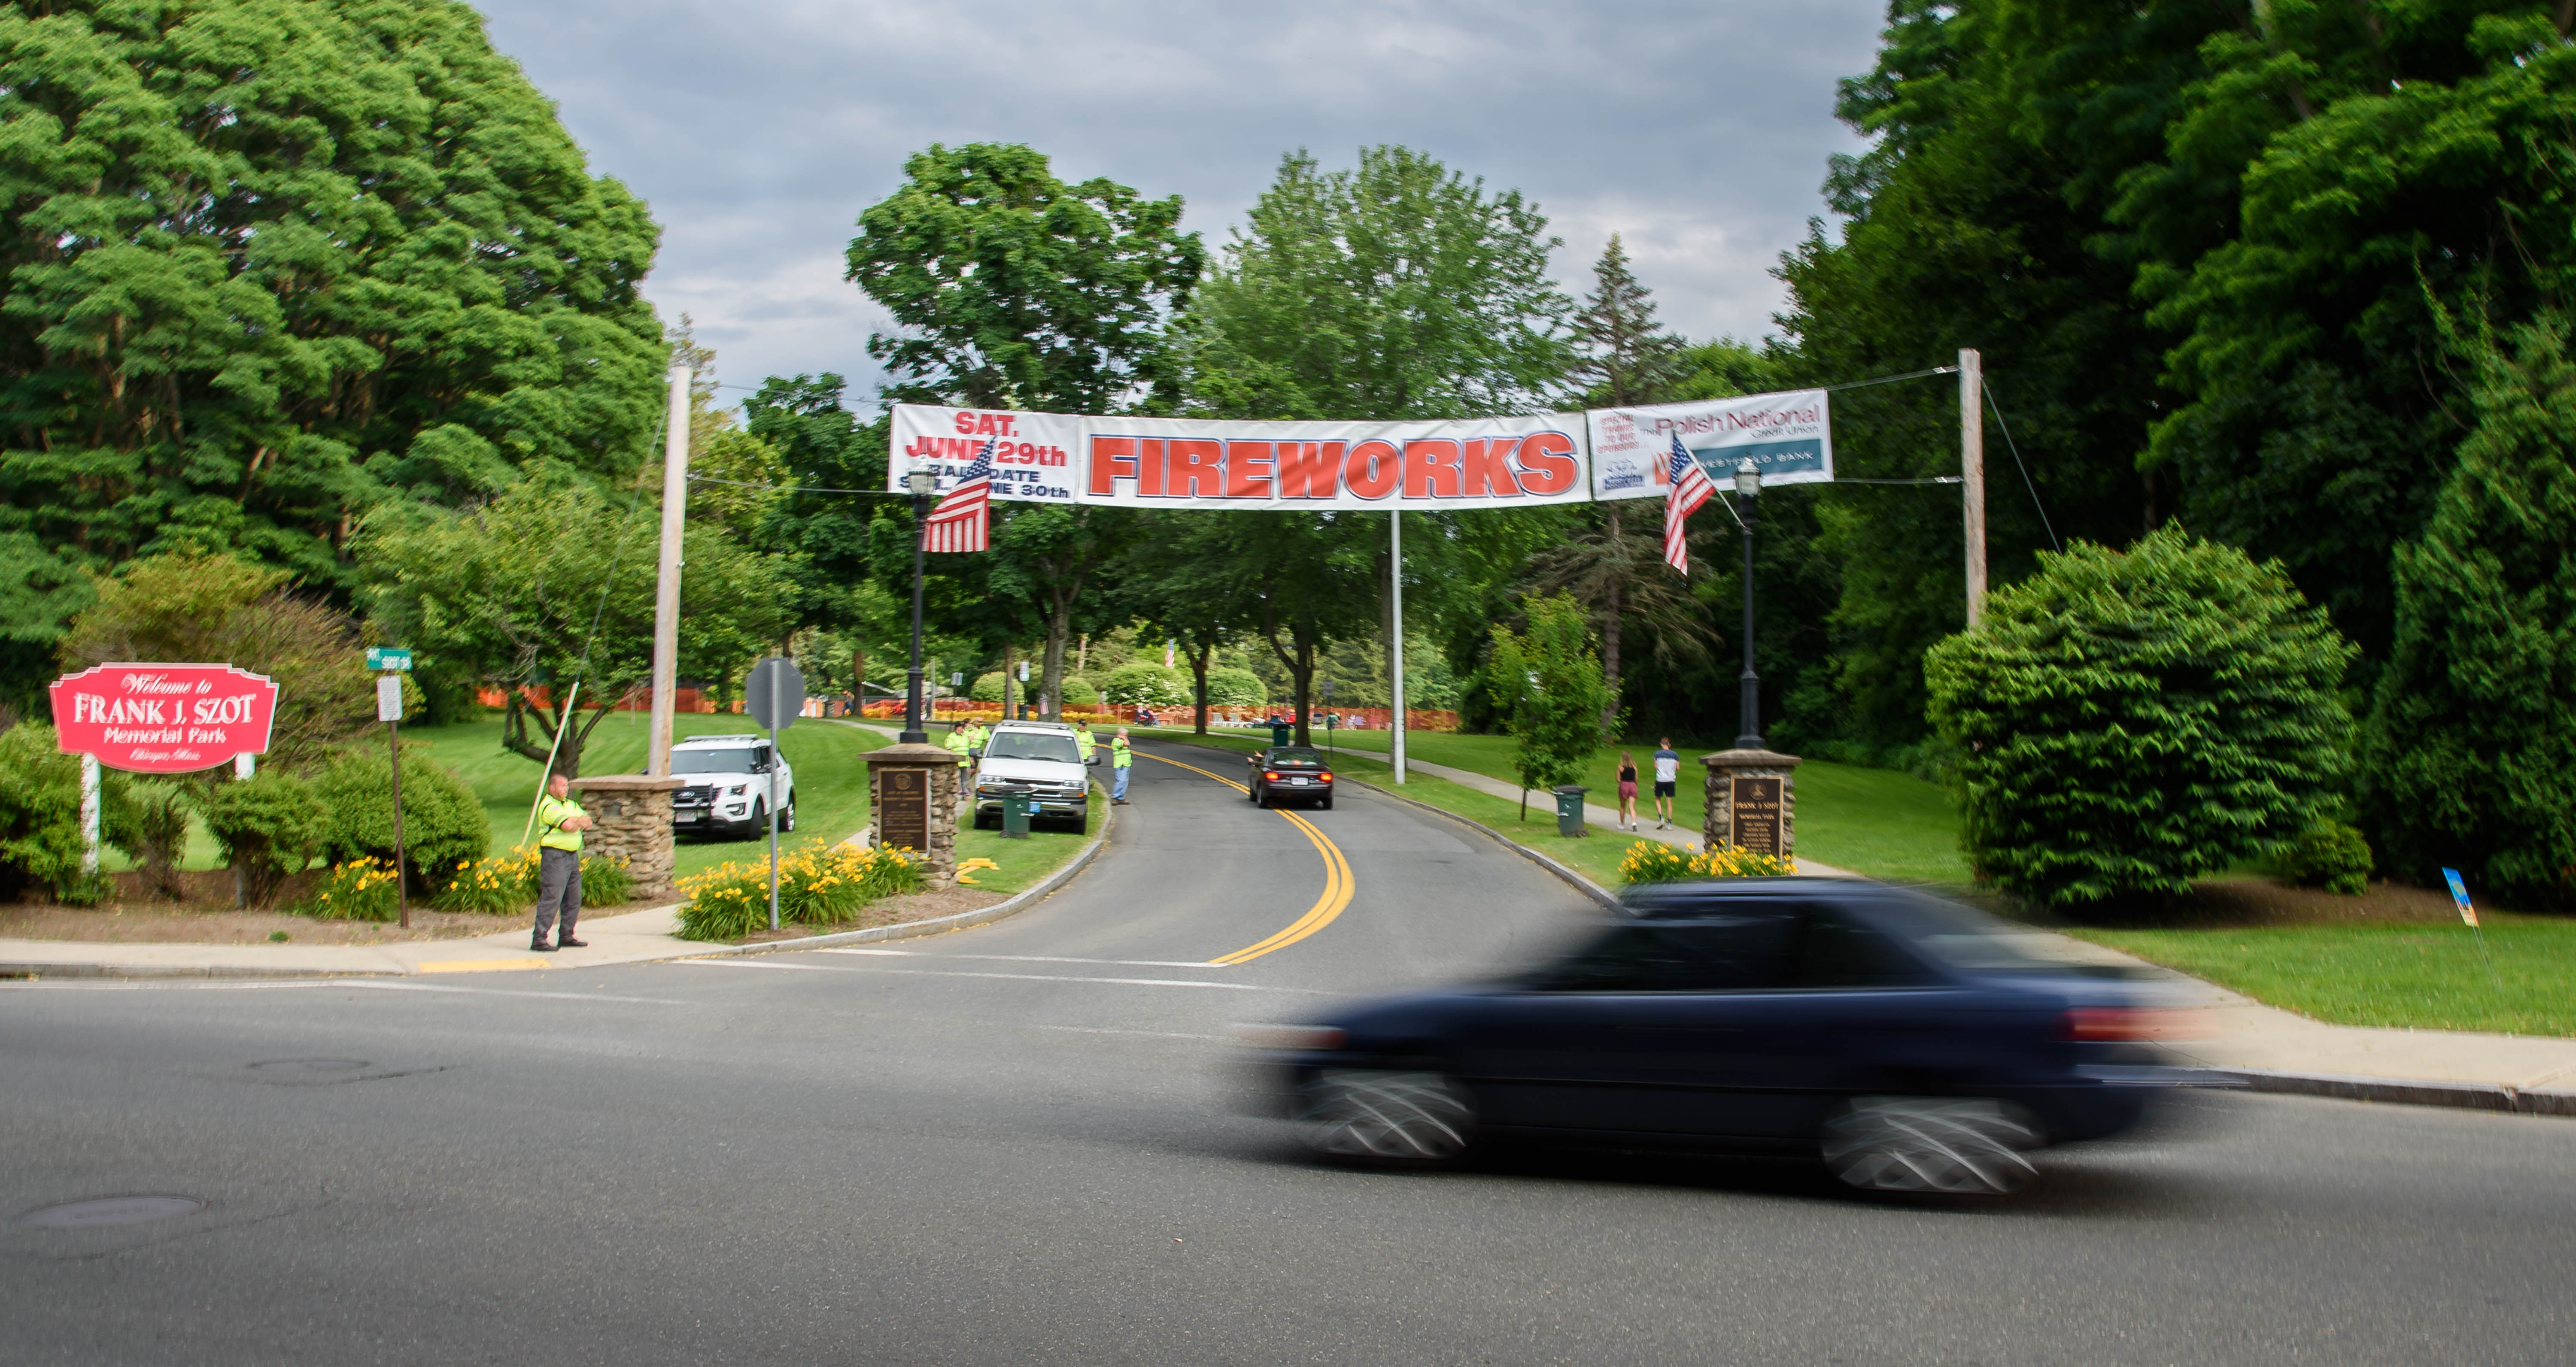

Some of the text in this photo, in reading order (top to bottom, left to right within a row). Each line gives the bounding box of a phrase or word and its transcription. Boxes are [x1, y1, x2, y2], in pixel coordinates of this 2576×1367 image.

[955, 411, 1019, 437] SAT.
[1654, 413, 1725, 437] Polish
[1726, 403, 1821, 430] National
[1750, 425, 1819, 439] Credit Union
[905, 436, 1069, 467] JUNE 29th
[1776, 451, 1814, 462] BANK
[989, 468, 1041, 482] DATE
[1087, 430, 1579, 500] FIREWORKS
[1021, 484, 1069, 498] 30th
[121, 673, 212, 694] Welcome to
[73, 692, 257, 724] FRANK J. SZOT
[103, 726, 227, 744] Memorial Park
